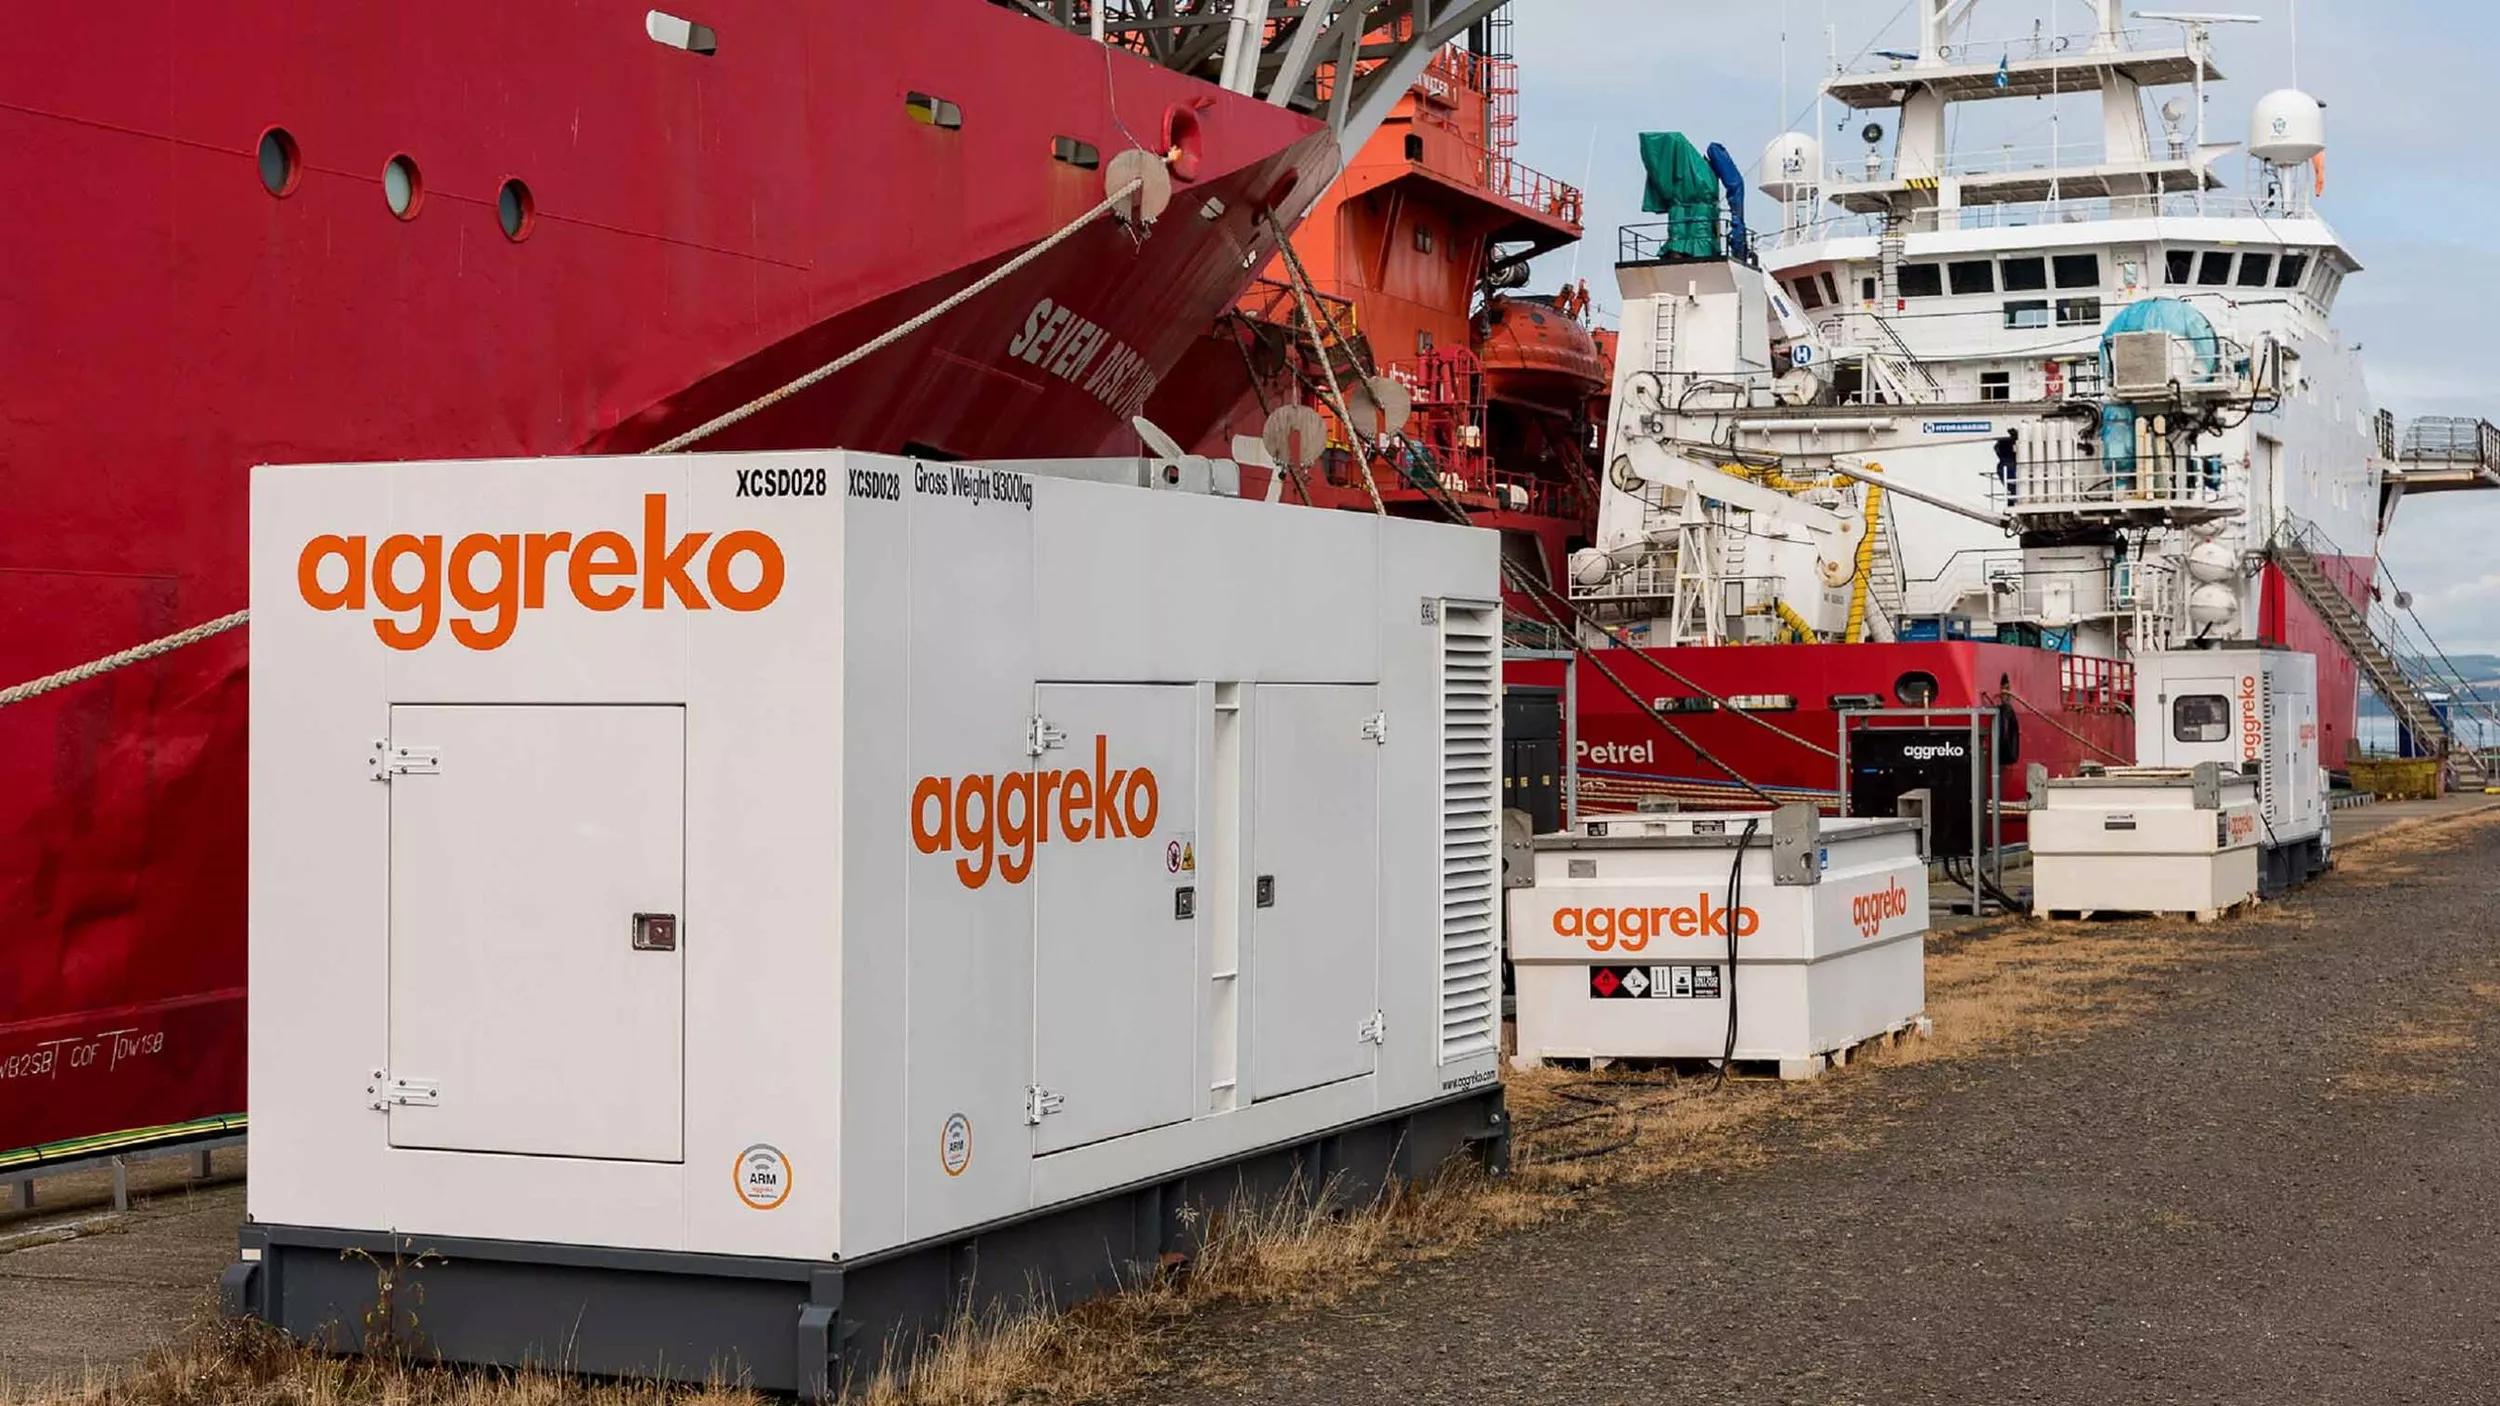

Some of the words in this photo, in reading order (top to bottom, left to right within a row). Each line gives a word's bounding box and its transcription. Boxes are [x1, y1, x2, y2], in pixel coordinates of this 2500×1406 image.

[1009, 297, 1111, 383] SEVEN
[736, 468, 827, 498] XCSD028
[849, 468, 900, 502] XCSD028
[914, 462, 948, 496] Gross
[951, 466, 991, 506] Weight
[992, 471, 1033, 511] 9300kg
[298, 493, 785, 651] aggreko
[2238, 676, 2261, 760] aggreko
[1576, 740, 1654, 763] Petrel
[1904, 741, 1964, 759] aggreko
[911, 735, 1159, 889] aggreko
[1553, 893, 1760, 951] aggreko
[1853, 875, 1907, 938] aggreko
[1442, 1070, 1496, 1092] www.aggreko.com
[749, 1173, 777, 1185] ARM
